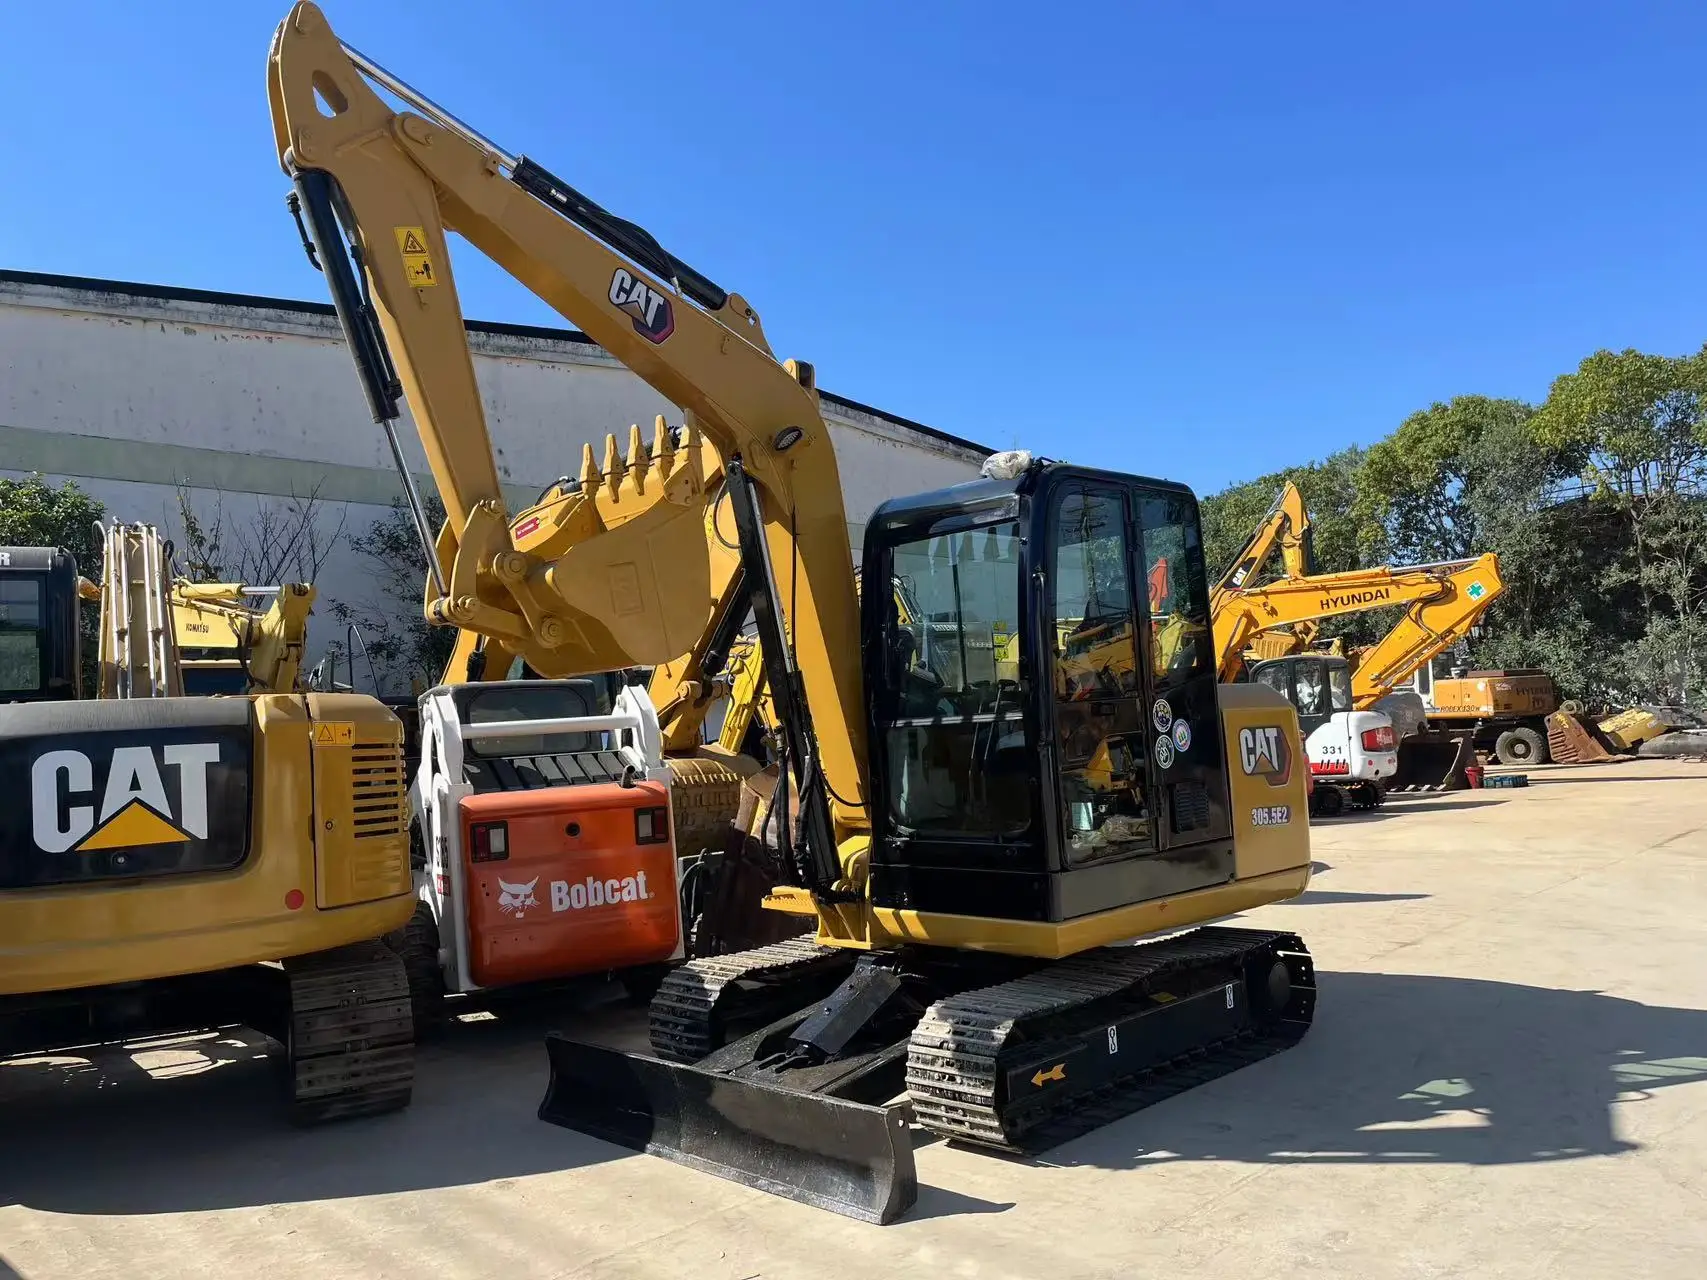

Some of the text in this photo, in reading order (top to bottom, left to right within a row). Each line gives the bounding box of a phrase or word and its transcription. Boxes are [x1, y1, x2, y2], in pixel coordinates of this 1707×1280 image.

[609, 268, 665, 328] CAT
[1232, 567, 1248, 586] CAT
[1320, 588, 1390, 610] HYUNDAI
[186, 623, 209, 634] KOMATSU
[1240, 728, 1279, 775] CAT
[1322, 745, 1342, 755] 331
[31, 743, 220, 853] CAT
[1251, 806, 1288, 825] 305.5E2
[550, 870, 649, 913] Bobcat
